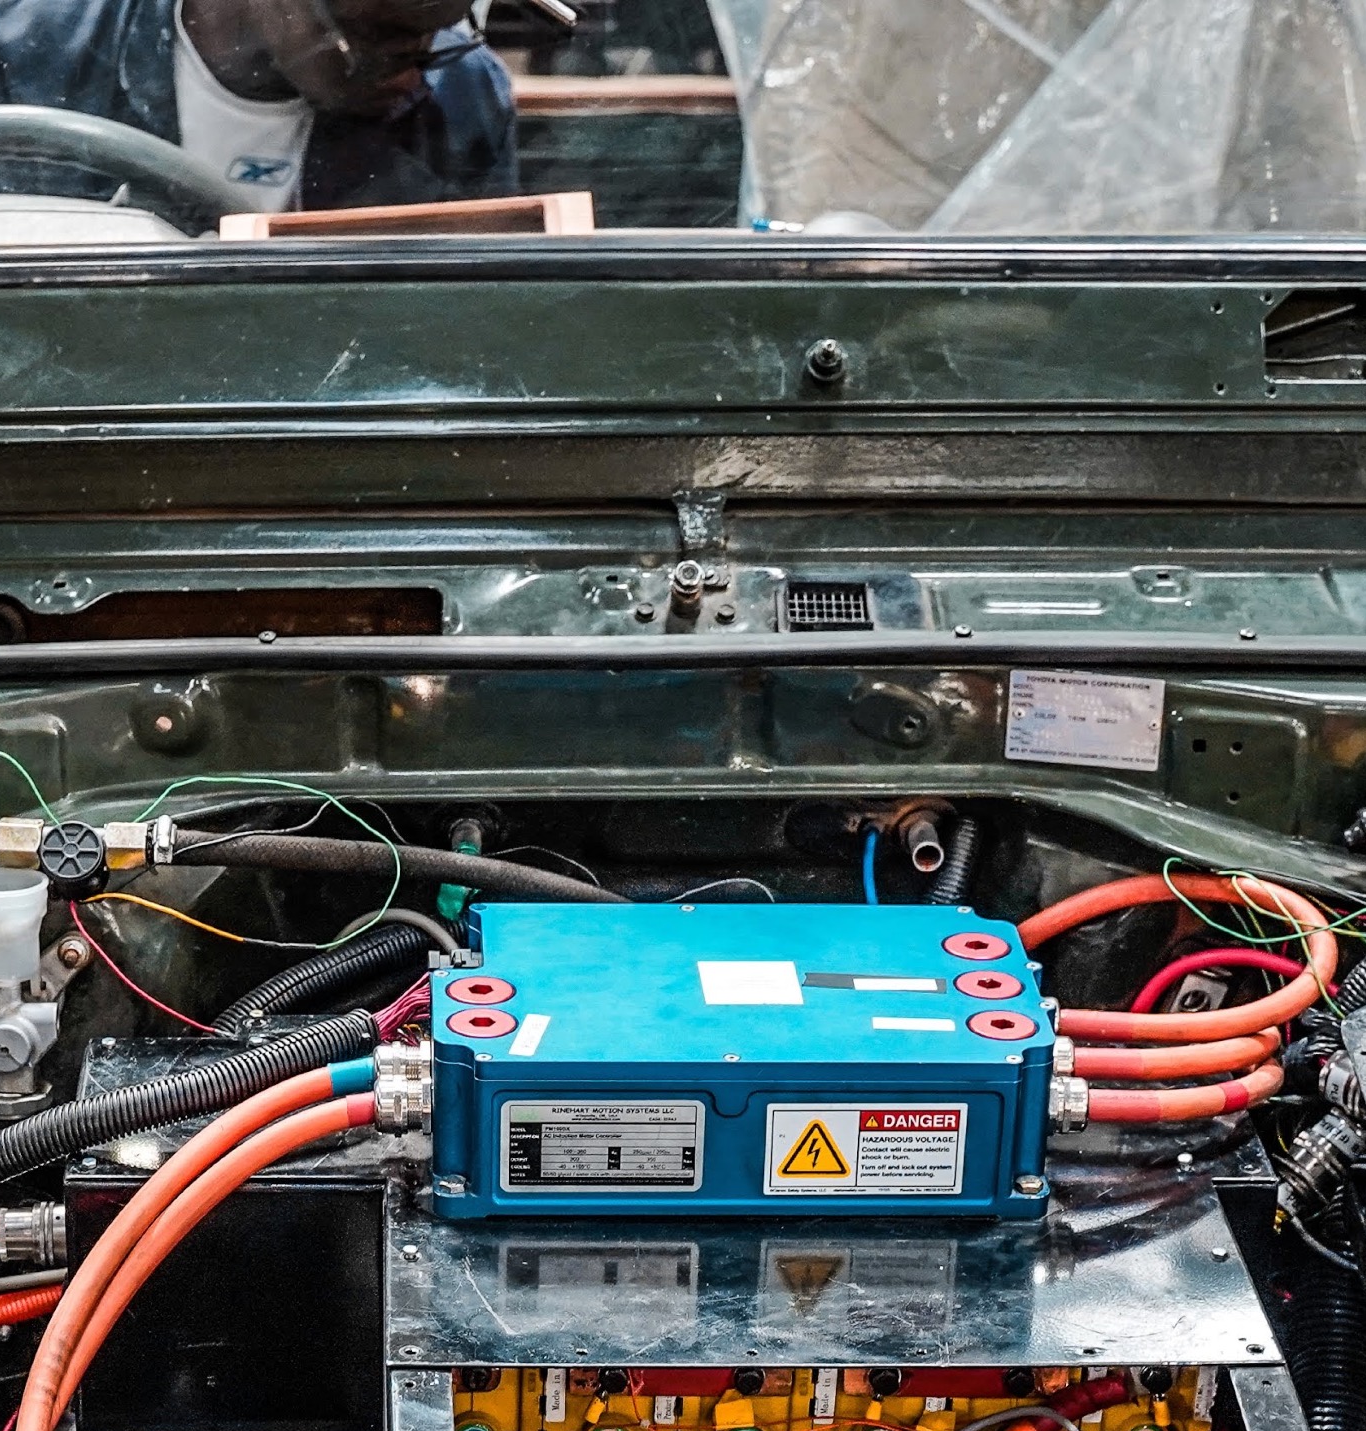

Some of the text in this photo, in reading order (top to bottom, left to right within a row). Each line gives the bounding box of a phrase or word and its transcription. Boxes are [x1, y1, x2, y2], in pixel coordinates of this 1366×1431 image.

[884, 1114, 956, 1128] DANGER
[822, 1377, 830, 1388] in
[551, 1373, 561, 1412] Made in
[820, 1397, 830, 1421] Made
